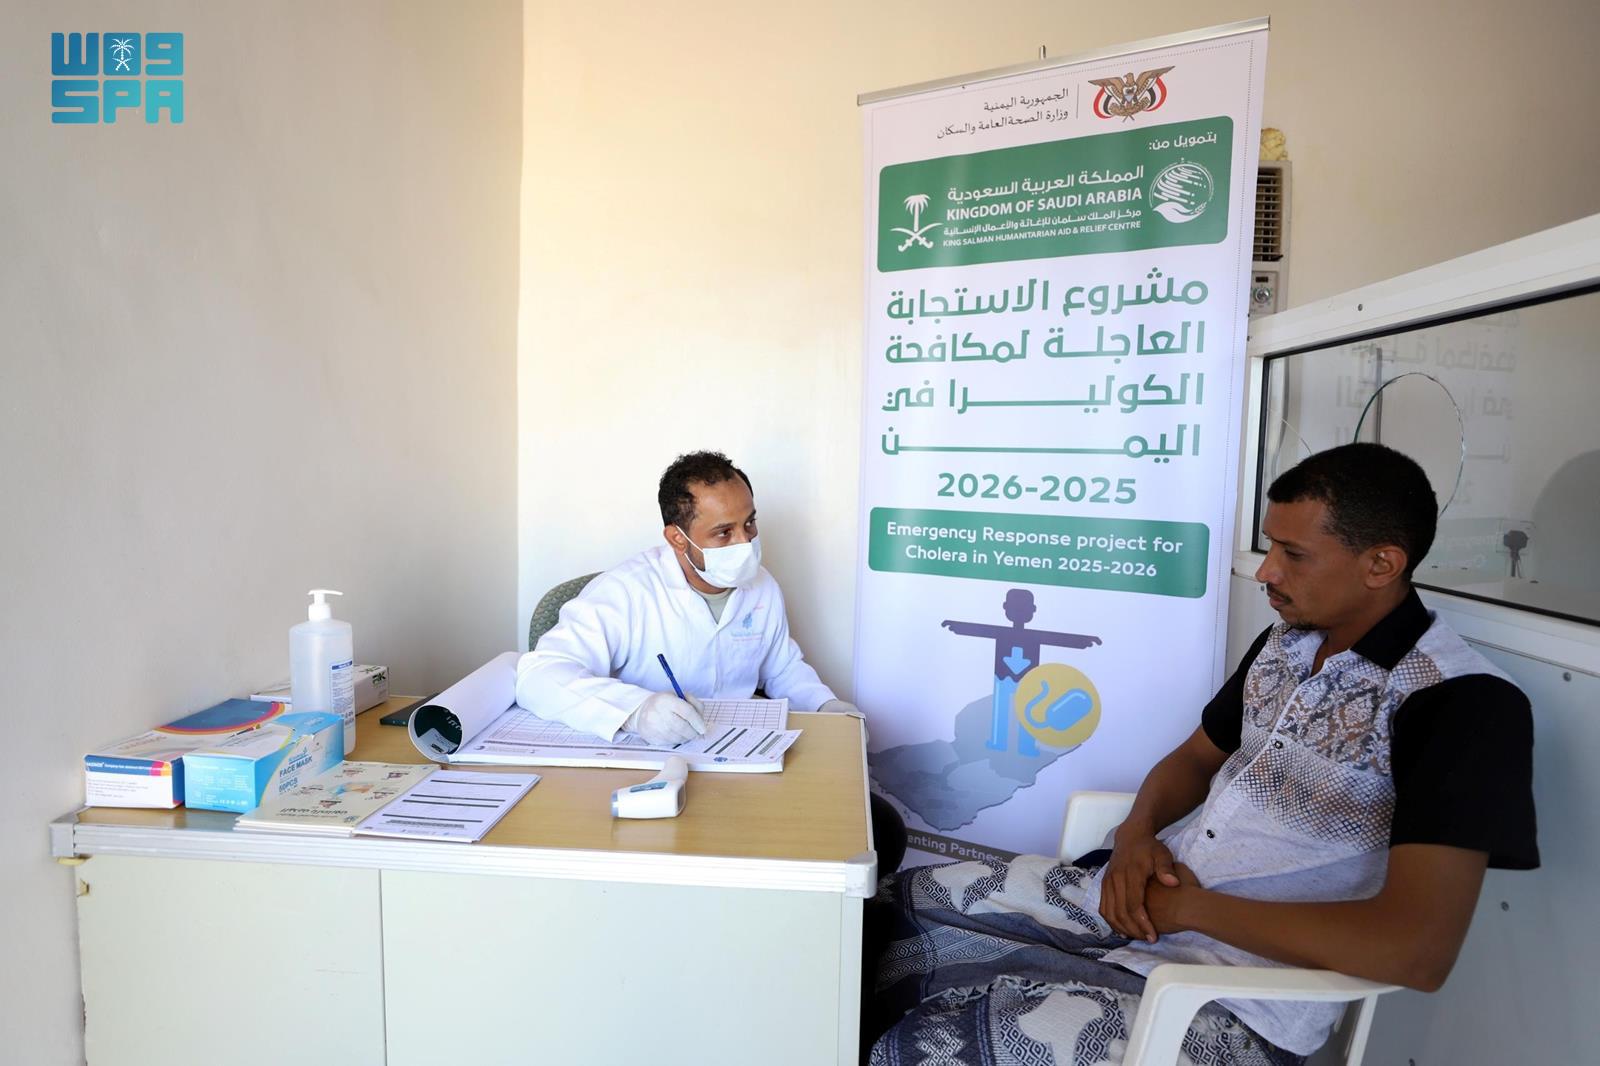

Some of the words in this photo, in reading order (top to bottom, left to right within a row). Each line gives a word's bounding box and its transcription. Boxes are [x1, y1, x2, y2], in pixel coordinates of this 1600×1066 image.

[984, 97, 1016, 112] اليمنية
[1020, 88, 1068, 109] الجمهورية
[978, 117, 1007, 130] العامة
[1008, 111, 1043, 125] الصحة
[1046, 109, 1068, 122] وزارة
[937, 123, 976, 139] والسكان
[1174, 132, 1217, 148] بتمويل
[1149, 139, 1170, 150] من:
[1022, 174, 1074, 195] العربية
[1079, 165, 1144, 185] المملكة
[947, 182, 1017, 204] السعودية
[947, 202, 1012, 221] KINGDOM
[1016, 199, 1034, 213] OF
[1037, 194, 1082, 211] SAUDI
[1085, 187, 1142, 205] ARABIA
[1051, 213, 1086, 225] سلمان
[1087, 210, 1116, 222] الملك
[1117, 208, 1142, 221] مركز
[943, 237, 961, 247] KING
[962, 234, 994, 245] SALMAN
[995, 230, 1056, 242] HUMANITARIAN
[1058, 228, 1071, 236] AID
[1072, 227, 1079, 235] &
[1080, 224, 1107, 234] RELIEF
[1108, 220, 1141, 231] CENTRE
[887, 279, 1049, 325] الاستجابة
[1062, 267, 1209, 317] مشروع
[886, 330, 1029, 363] لمكافحة
[1044, 321, 1204, 364] العاجلة
[882, 380, 935, 411] في
[949, 373, 1203, 414] الكوليرا
[882, 424, 1200, 463] اليمن
[937, 473, 1136, 504] 2026-2025
[887, 522, 977, 543] Emergency
[983, 527, 1071, 546] Response
[1077, 533, 1147, 555] project
[1153, 537, 1183, 553] for
[906, 545, 968, 563] Cholera
[973, 548, 988, 564] in
[993, 551, 1052, 570] Yemen
[1059, 557, 1156, 577] 2025-2026
[280, 763, 296, 777] FACE
[296, 755, 312, 769] MASK
